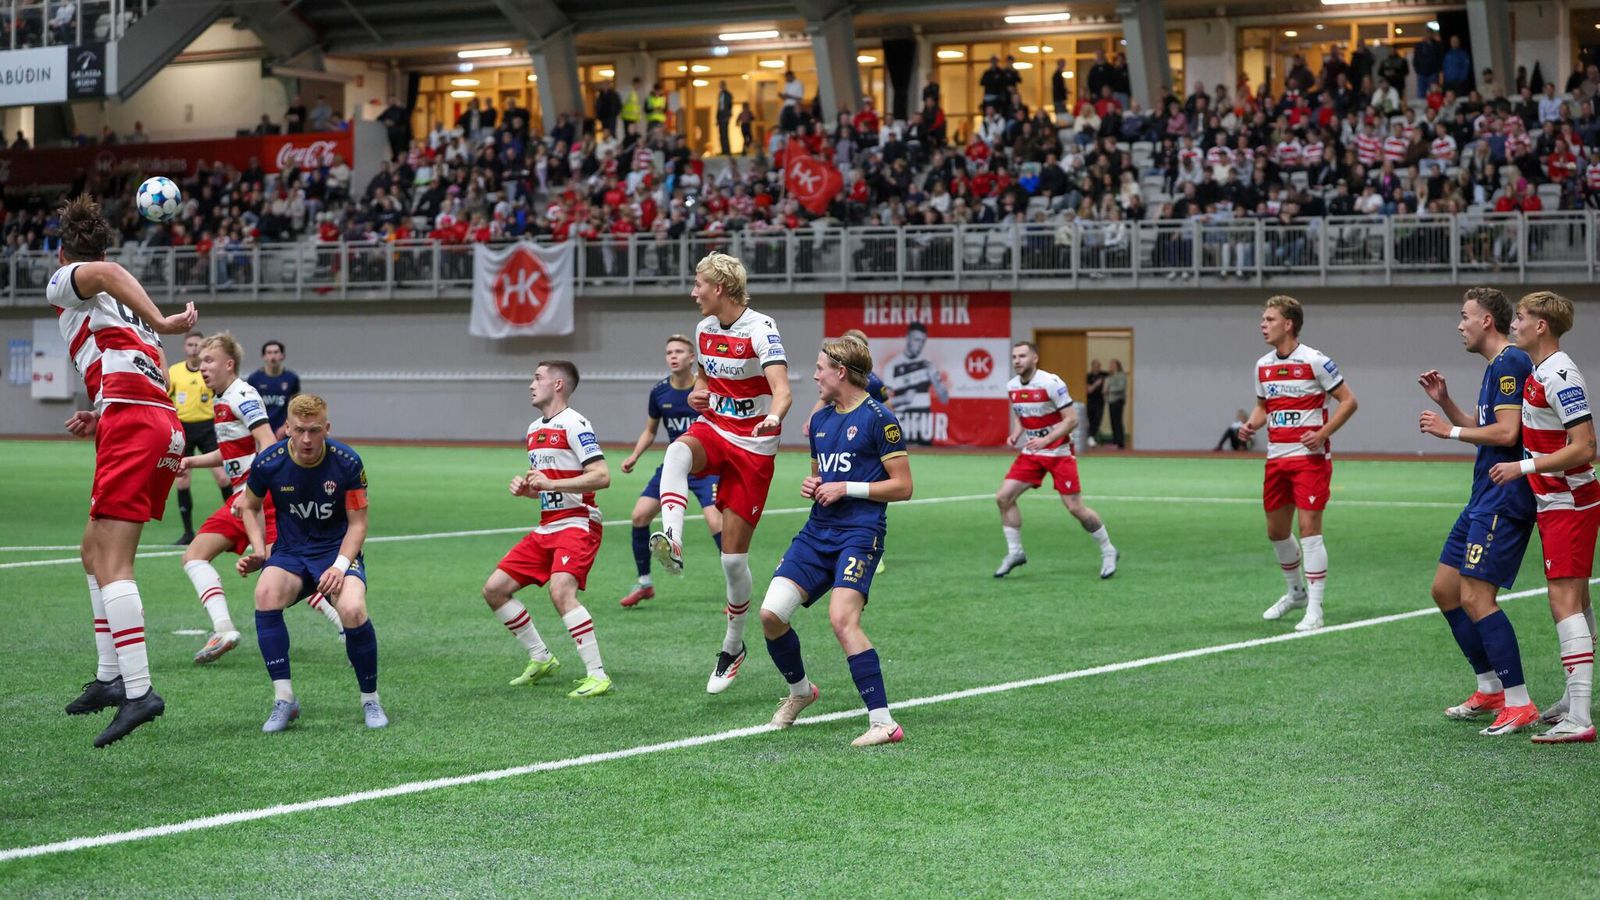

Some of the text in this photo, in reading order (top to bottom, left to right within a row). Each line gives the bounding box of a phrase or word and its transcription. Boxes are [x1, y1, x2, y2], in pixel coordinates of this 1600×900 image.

[790, 161, 822, 194] HK
[502, 268, 540, 308] HK
[863, 294, 971, 325] HERRA HK
[719, 363, 745, 376] Arion
[967, 356, 990, 373] HK
[1501, 380, 1515, 392] ups
[714, 393, 755, 417] KAPP
[1271, 411, 1301, 426] KAPP
[886, 427, 900, 441] ups
[540, 491, 563, 510] APP
[289, 500, 334, 520] AVIS
[1465, 542, 1483, 565] 10
[843, 556, 866, 579] 25
[842, 574, 858, 584] JAKO
[266, 658, 285, 666] JAKO
[861, 685, 875, 695] AKO
